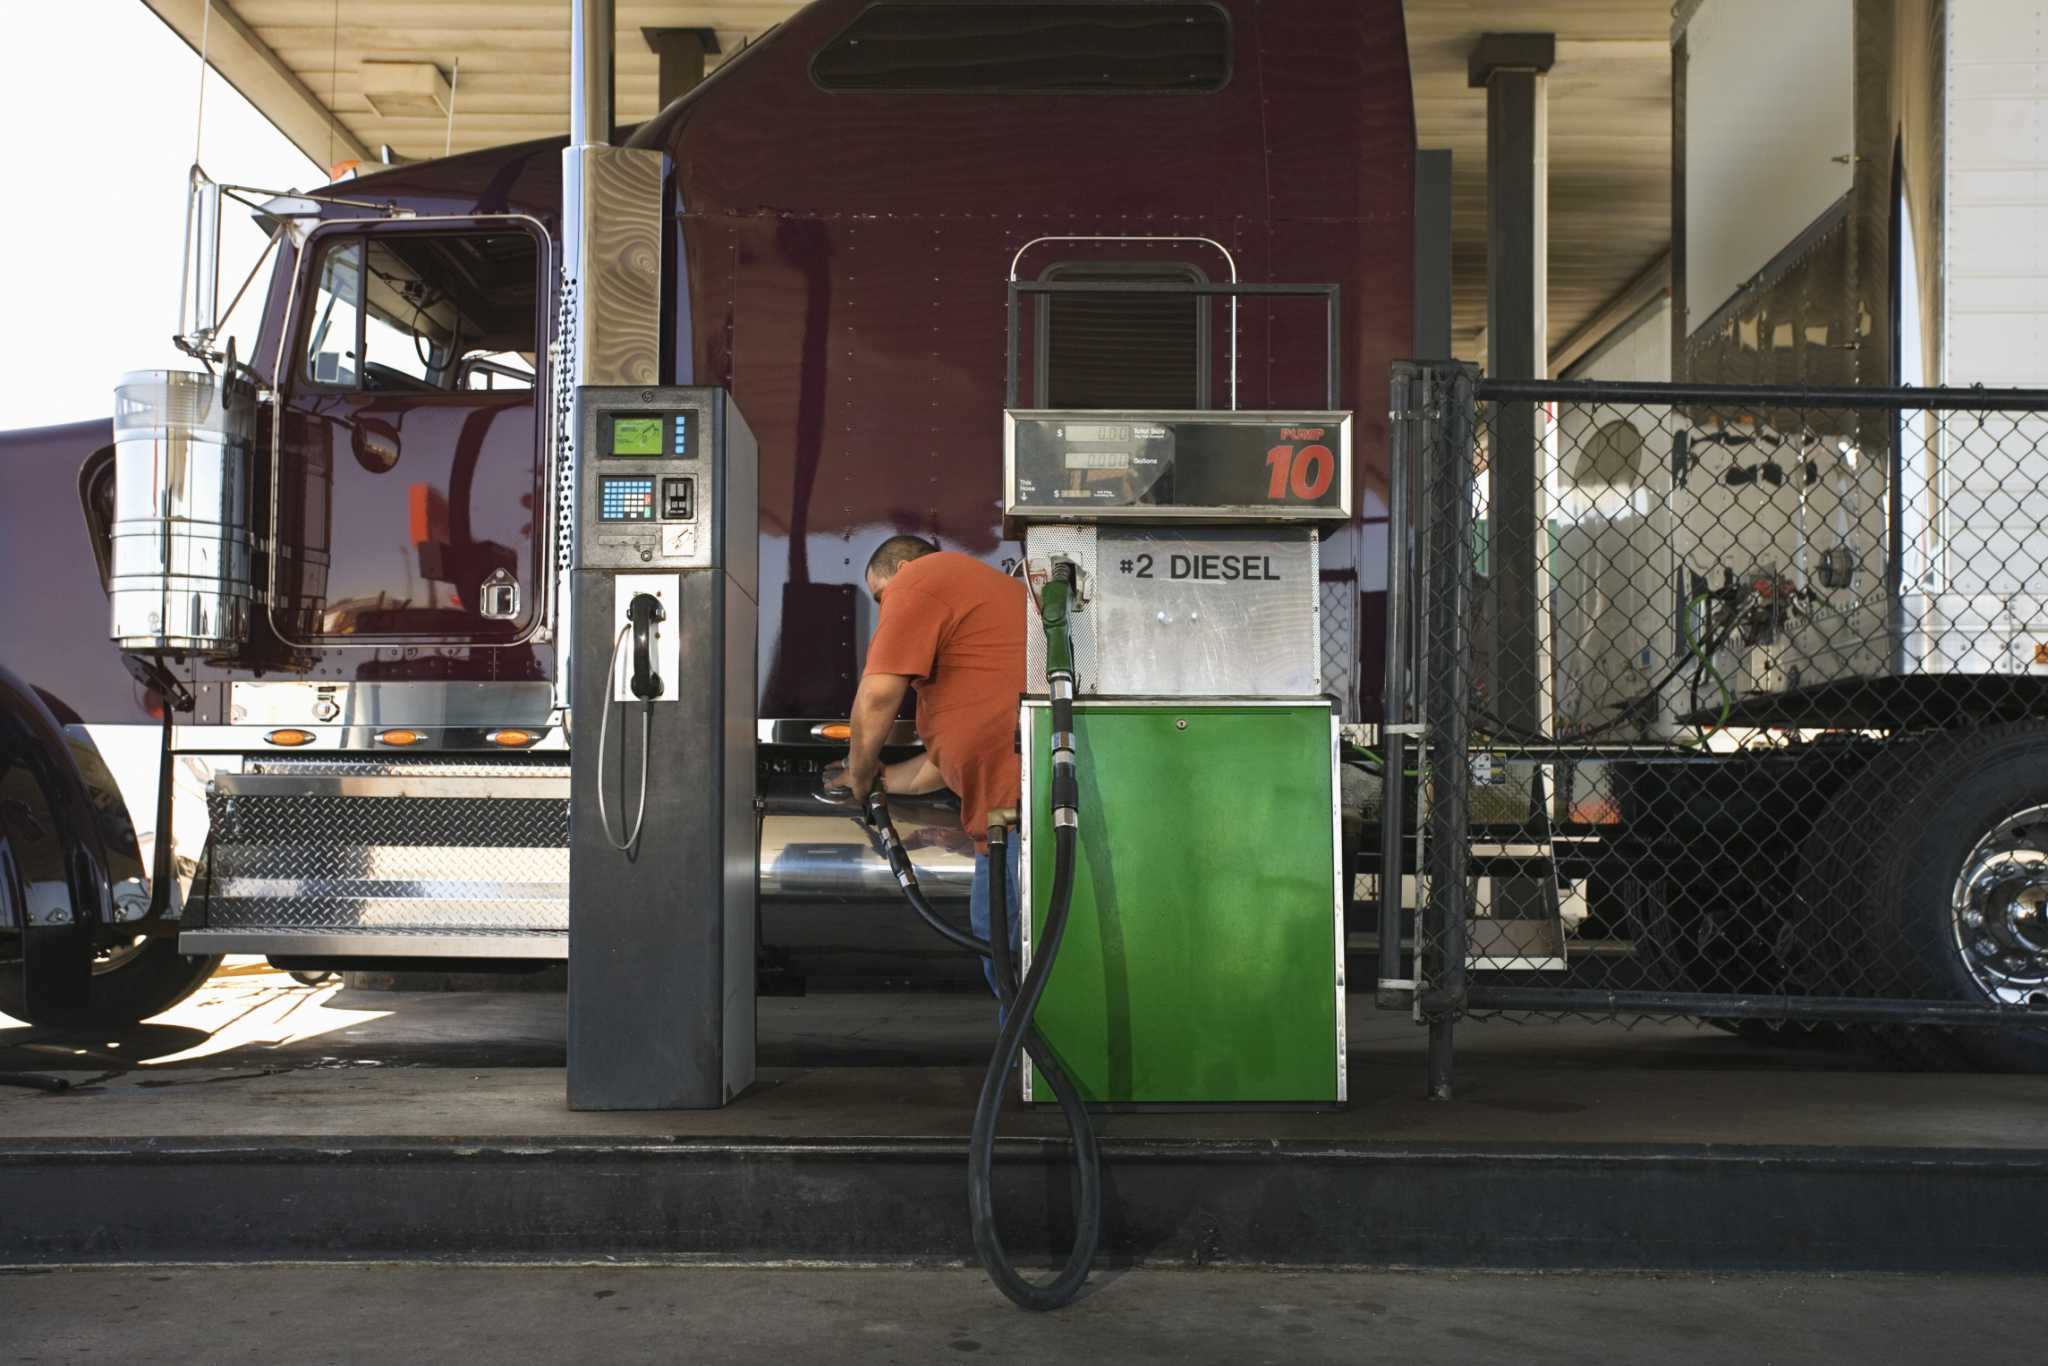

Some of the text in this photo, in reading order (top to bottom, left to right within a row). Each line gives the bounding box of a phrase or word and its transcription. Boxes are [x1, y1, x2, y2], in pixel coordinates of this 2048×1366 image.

[1265, 444, 1335, 499] 10
[1120, 553, 1281, 580] #2 DIESEL
